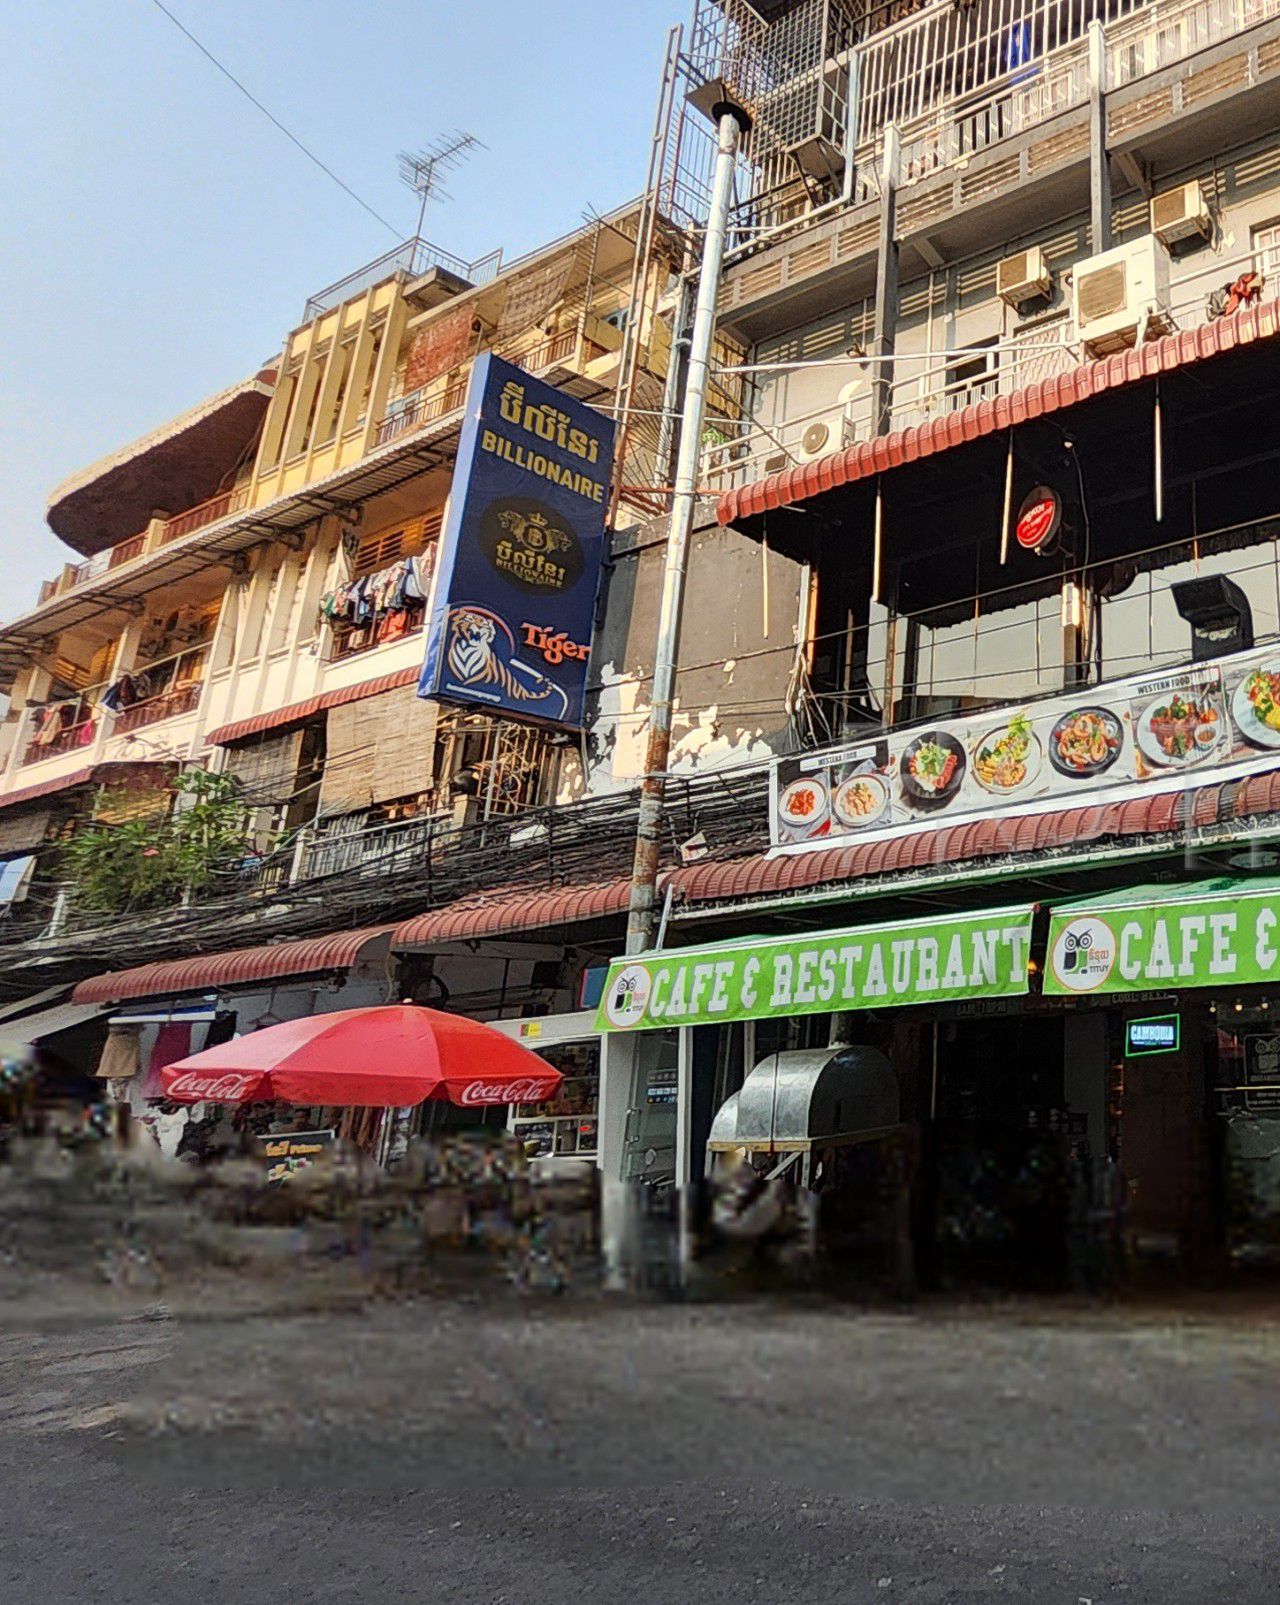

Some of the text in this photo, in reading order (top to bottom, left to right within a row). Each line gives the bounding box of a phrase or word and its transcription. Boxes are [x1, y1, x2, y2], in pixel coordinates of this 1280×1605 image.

[482, 430, 604, 503] BILLIONAIRE
[520, 622, 592, 664] Tiger
[1137, 676, 1190, 694] WESTERN FOOD
[1120, 913, 1238, 981] CAFE
[1256, 909, 1279, 971] &
[650, 925, 1030, 1018] CAFE & RESTAURANT
[1089, 965, 1109, 973] TITUY
[166, 1071, 252, 1100] Coca-Cola
[461, 1078, 547, 1105] Coca-Cola
